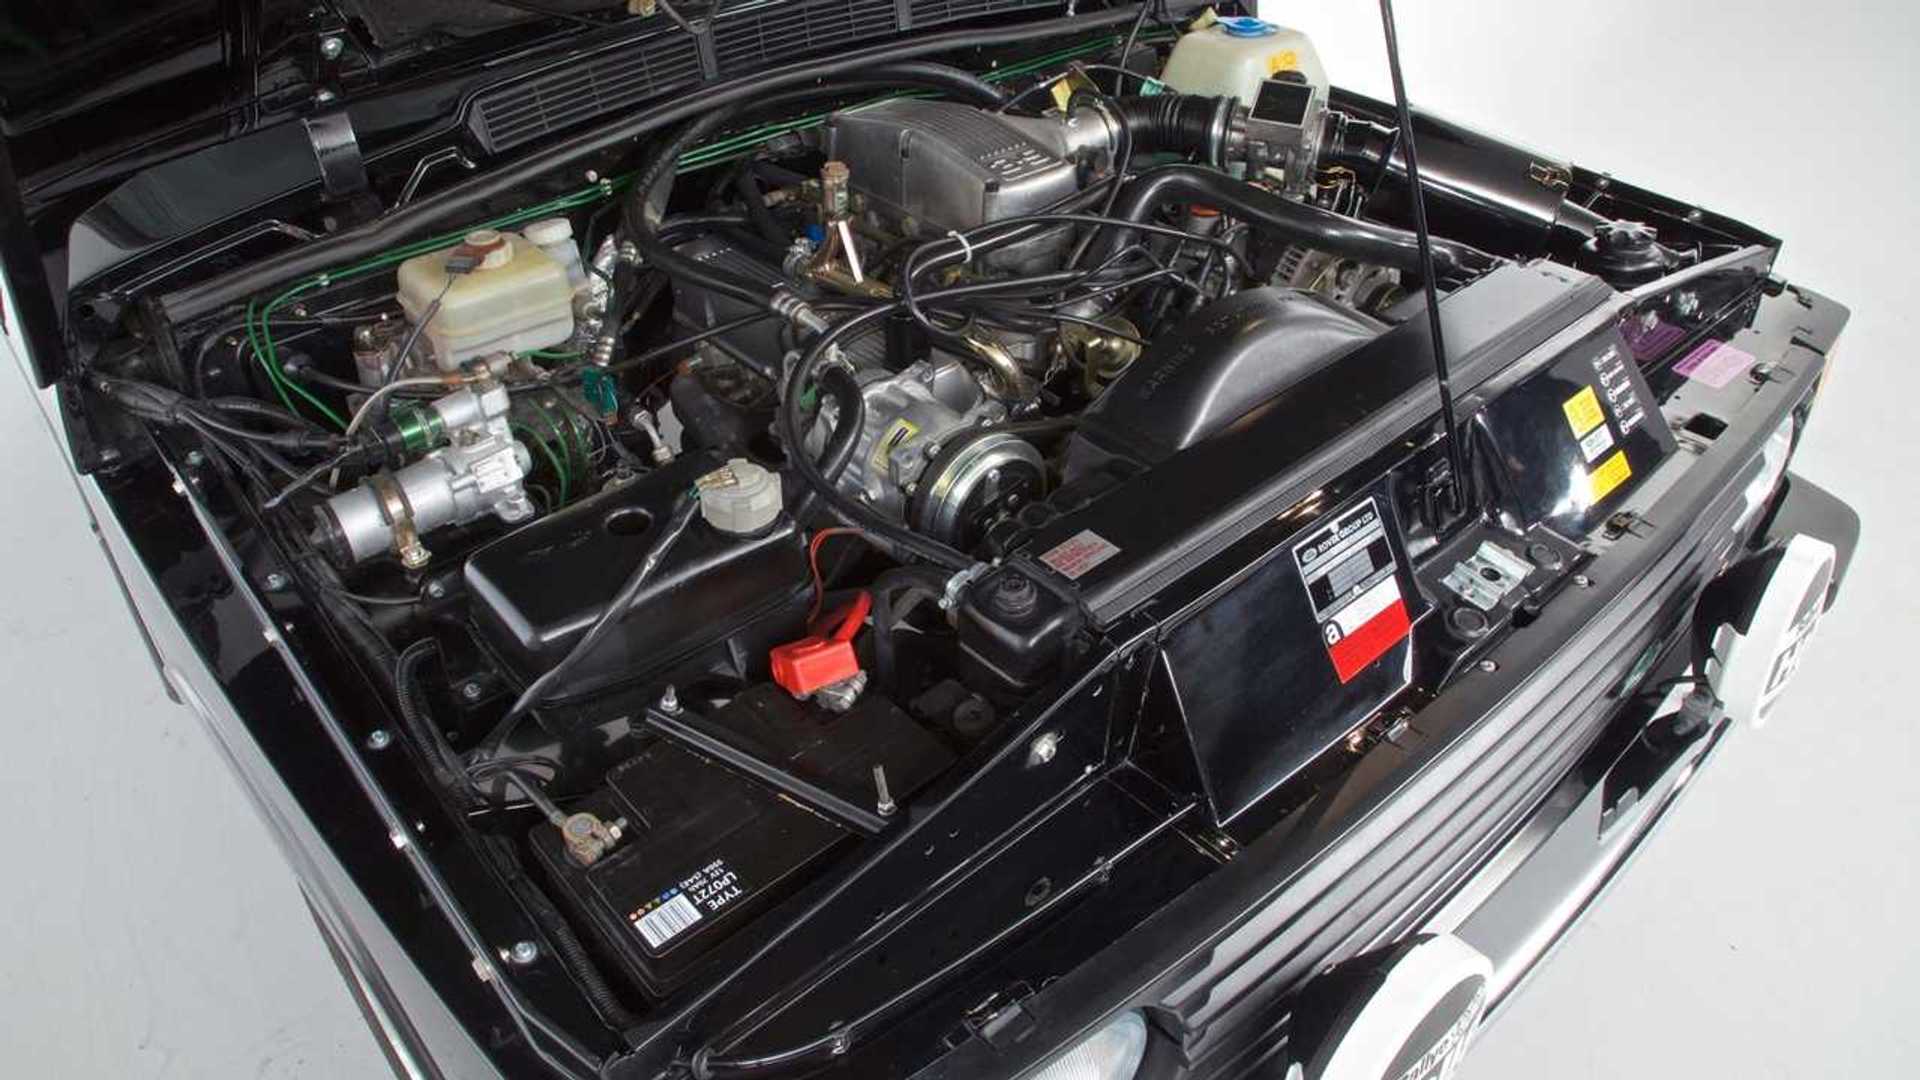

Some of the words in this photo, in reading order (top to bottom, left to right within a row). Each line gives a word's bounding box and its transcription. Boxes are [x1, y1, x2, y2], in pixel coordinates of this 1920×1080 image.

[1318, 533, 1341, 552] ROVER
[1339, 520, 1362, 538] GROUP
[1362, 511, 1374, 524] LTD
[692, 872, 737, 905] LP072T
[707, 886, 742, 910] TYPE
